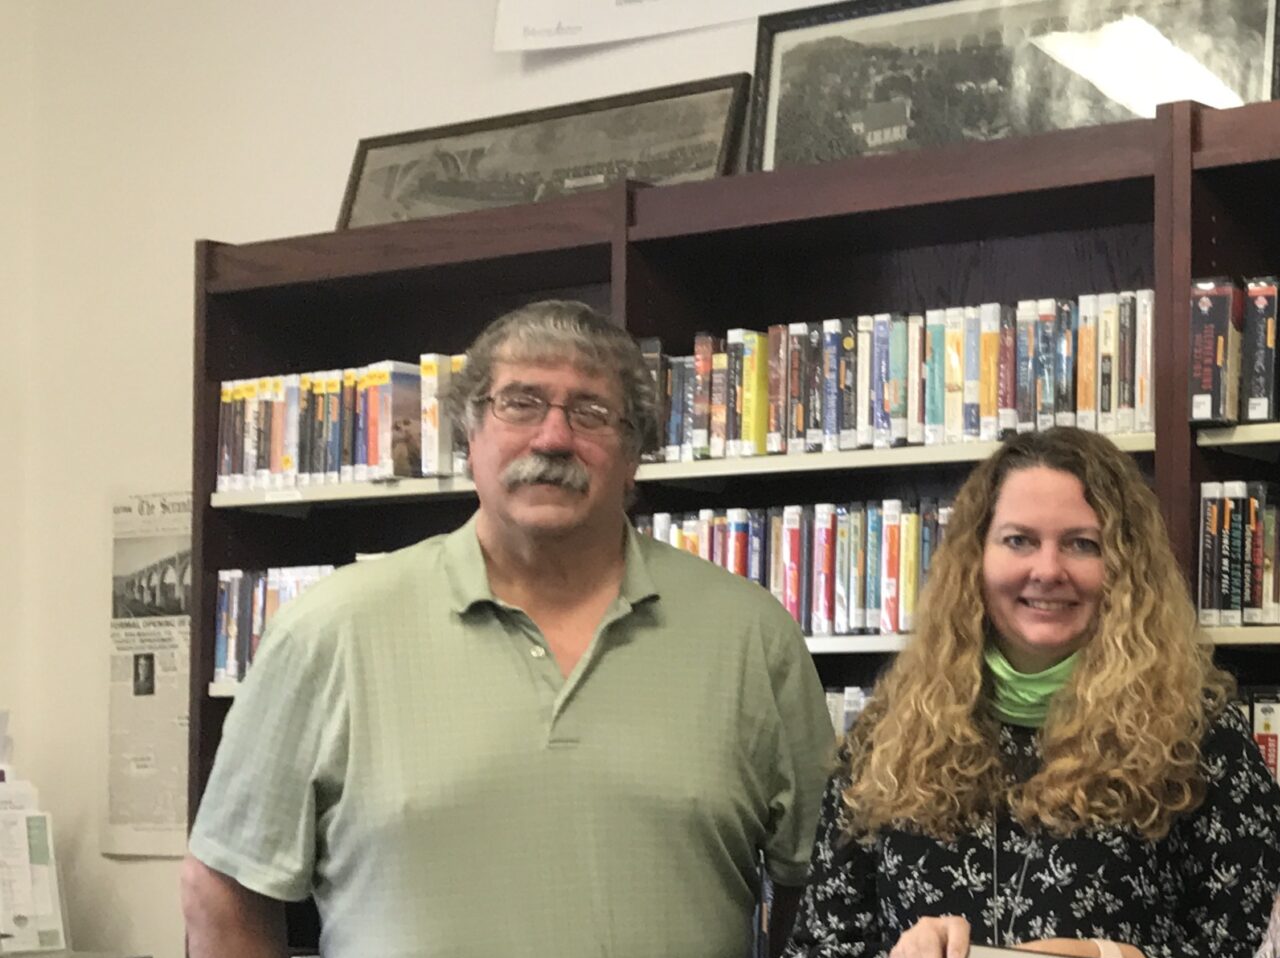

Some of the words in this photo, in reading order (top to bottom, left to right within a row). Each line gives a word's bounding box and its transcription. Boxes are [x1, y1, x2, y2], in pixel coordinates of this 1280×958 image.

[1222, 529, 1230, 556] SINCE
[1231, 513, 1241, 559] DENNIS
[1222, 573, 1230, 595] FELL
